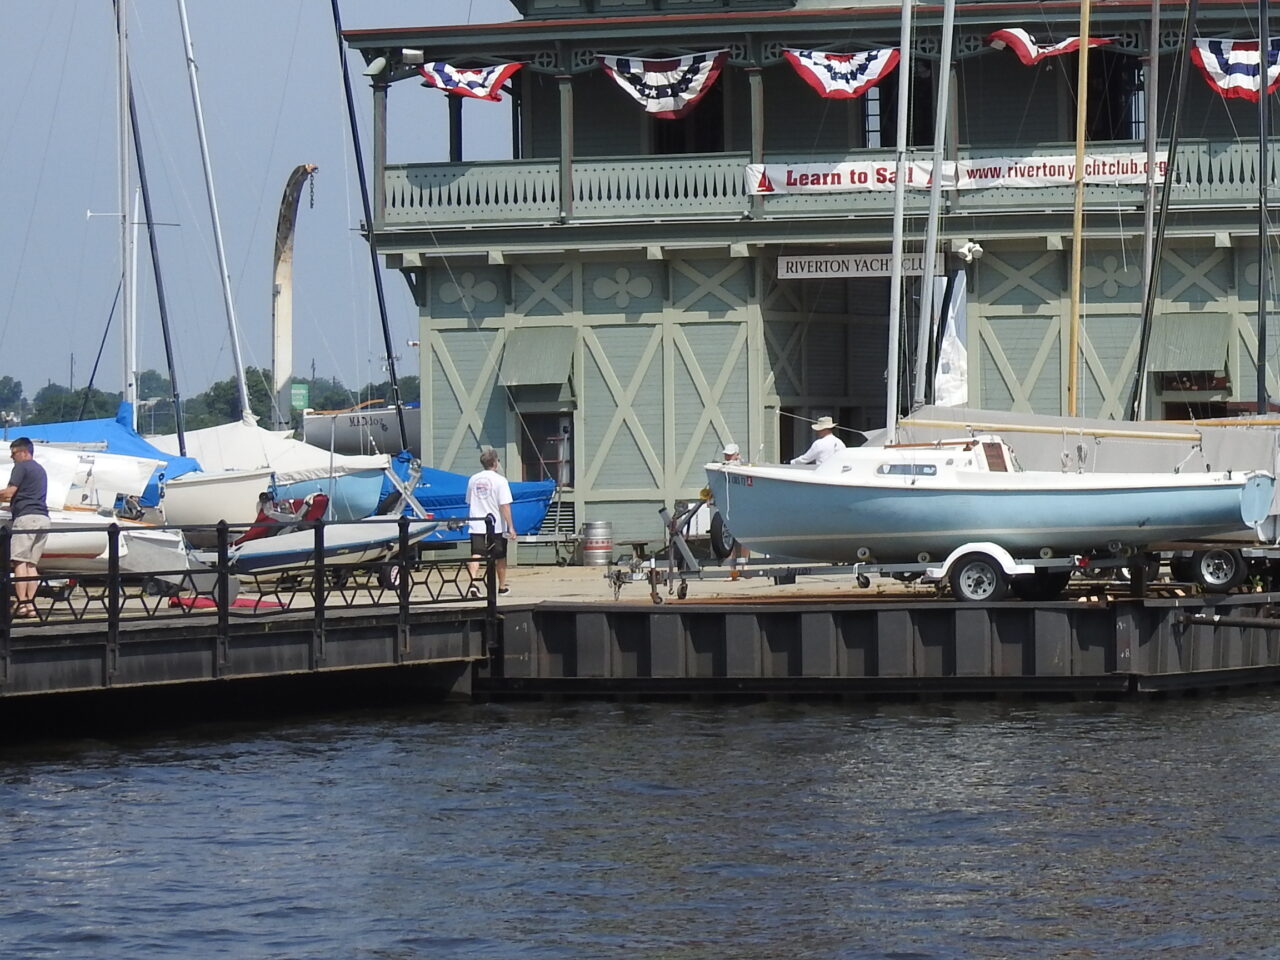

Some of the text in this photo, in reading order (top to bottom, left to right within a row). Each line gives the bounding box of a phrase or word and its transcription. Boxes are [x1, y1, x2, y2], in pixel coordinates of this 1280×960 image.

[786, 167, 913, 187] Learn to Sal
[786, 257, 937, 274] RIVERTON YACH CLU
